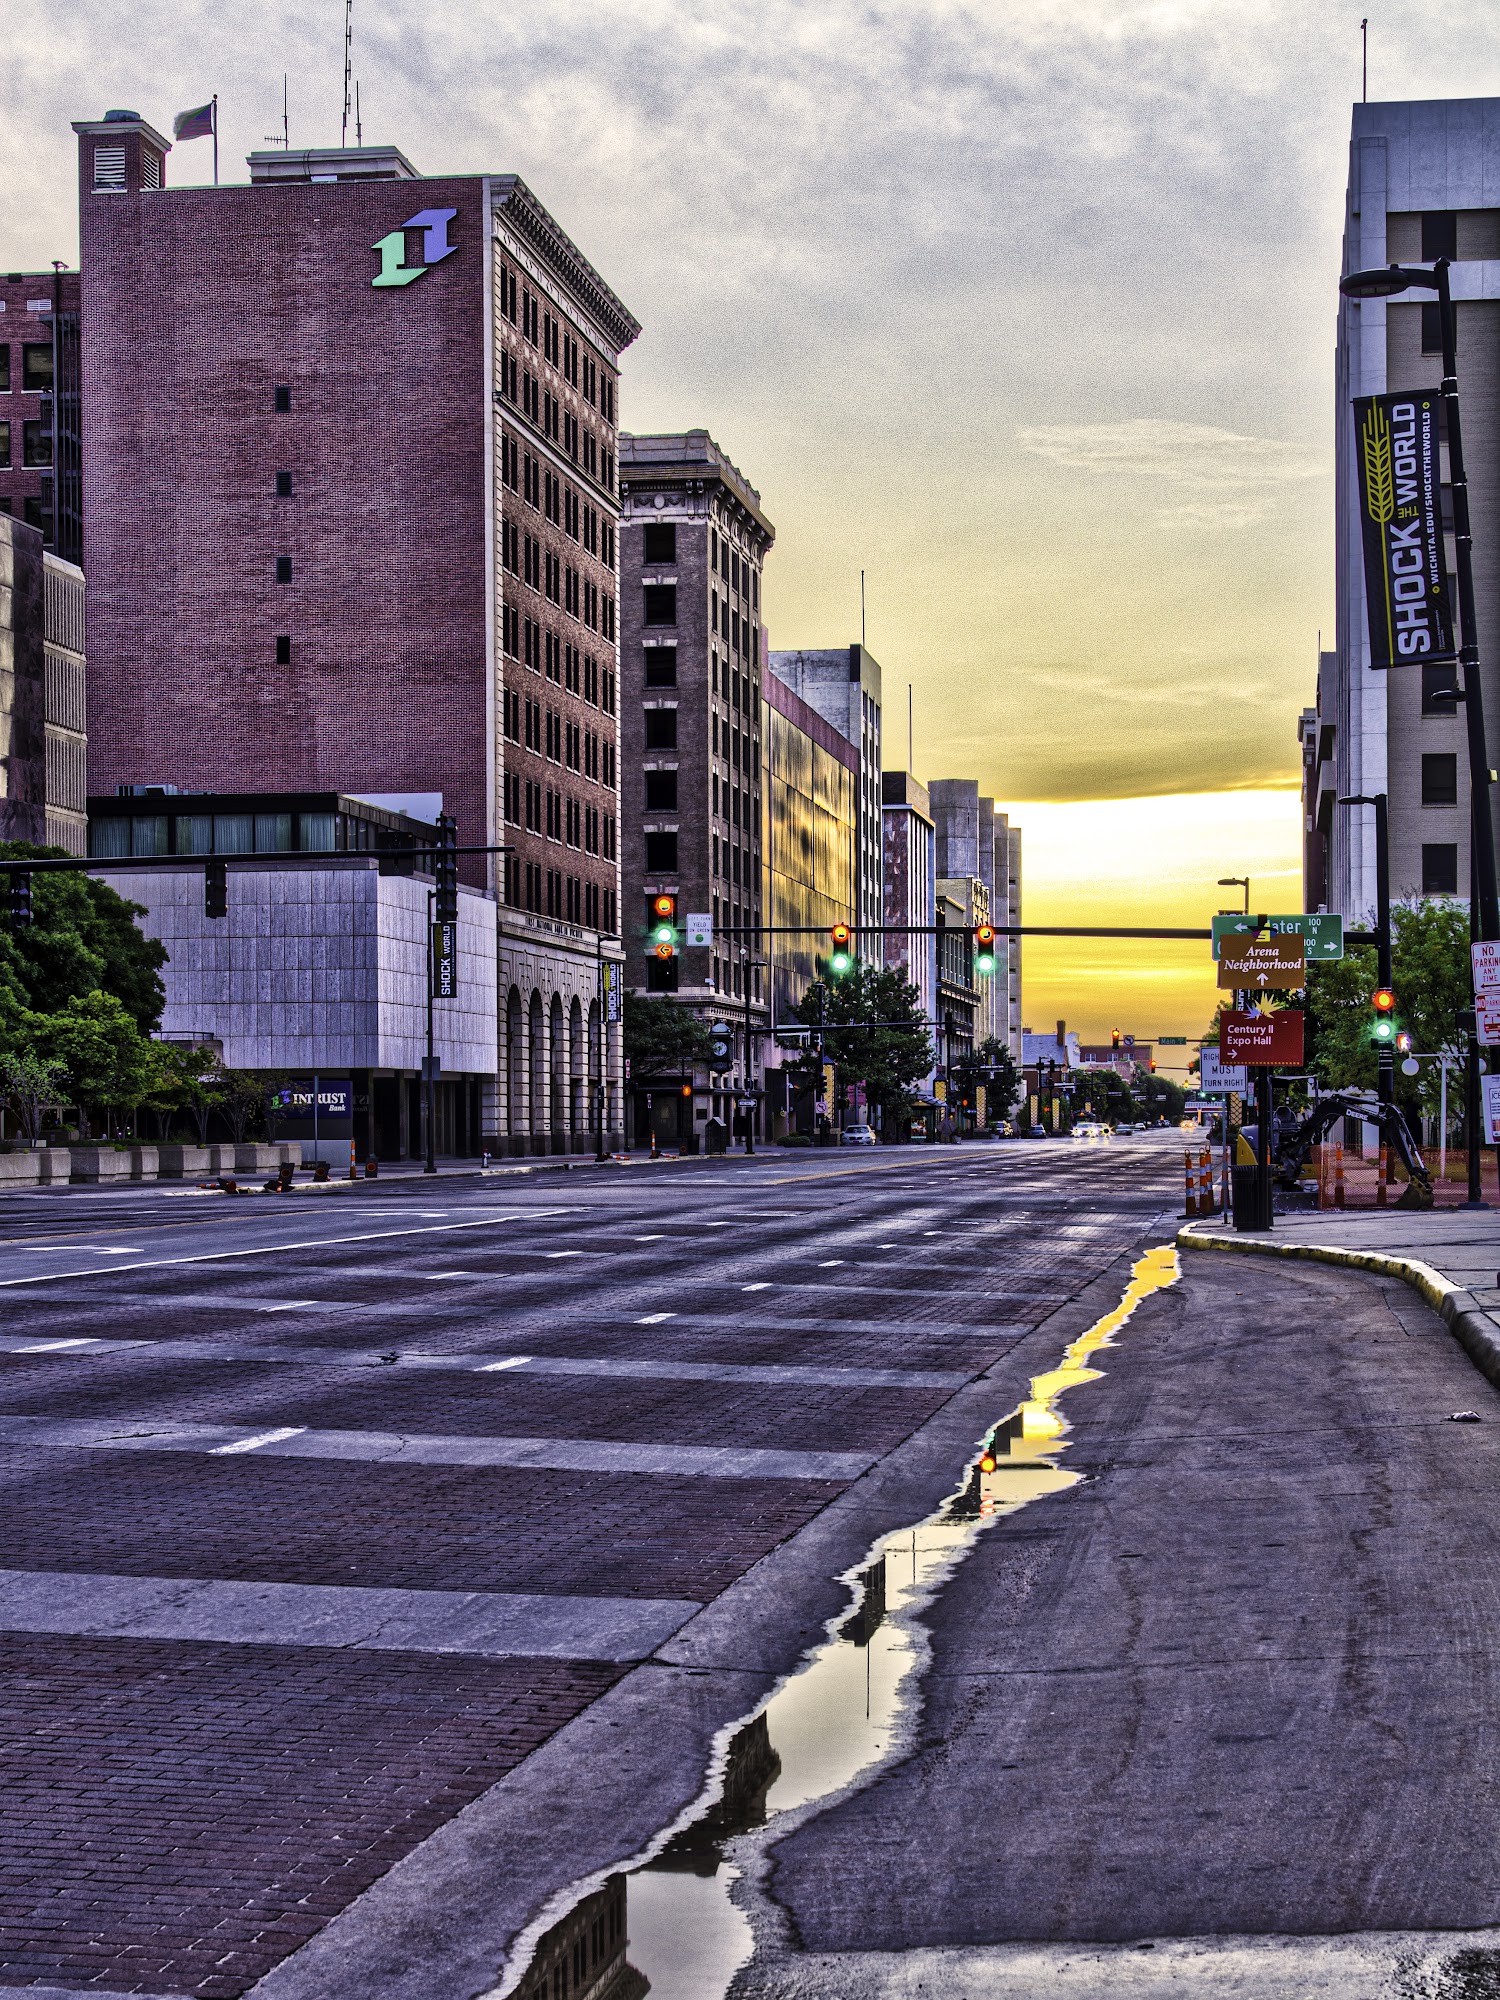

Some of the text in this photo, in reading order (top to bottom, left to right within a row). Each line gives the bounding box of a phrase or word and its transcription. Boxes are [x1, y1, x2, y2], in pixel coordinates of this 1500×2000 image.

[1422, 412, 1439, 584] WICHITA.EDU/SHOCKTHEWORLD
[1390, 403, 1431, 654] SHOCK THE WORLD
[1267, 920, 1301, 934] ater
[1308, 918, 1321, 926] 100
[1312, 927, 1318, 935] N
[443, 925, 451, 954] WORLD
[1246, 946, 1279, 957] Arena
[1307, 947, 1312, 955] S
[1482, 946, 1495, 956] NO
[1224, 958, 1301, 972] Neighborhood
[1475, 957, 1500, 968] PARKIN
[440, 958, 451, 995] SHOCK
[609, 963, 617, 987] WORLD
[1483, 974, 1498, 982] TIME
[608, 990, 617, 1020] SHOCK
[1477, 999, 1486, 1008] NO
[1227, 1024, 1266, 1035] Century
[1161, 1037, 1176, 1045] Main
[1227, 1036, 1272, 1047] Expo Hall
[1203, 1053, 1220, 1061] RIGH
[1211, 1065, 1236, 1075] MUST
[1204, 1078, 1244, 1087] TURN RIGHT
[329, 1104, 346, 1112] Bank
[1345, 1109, 1369, 1121] DEERE
